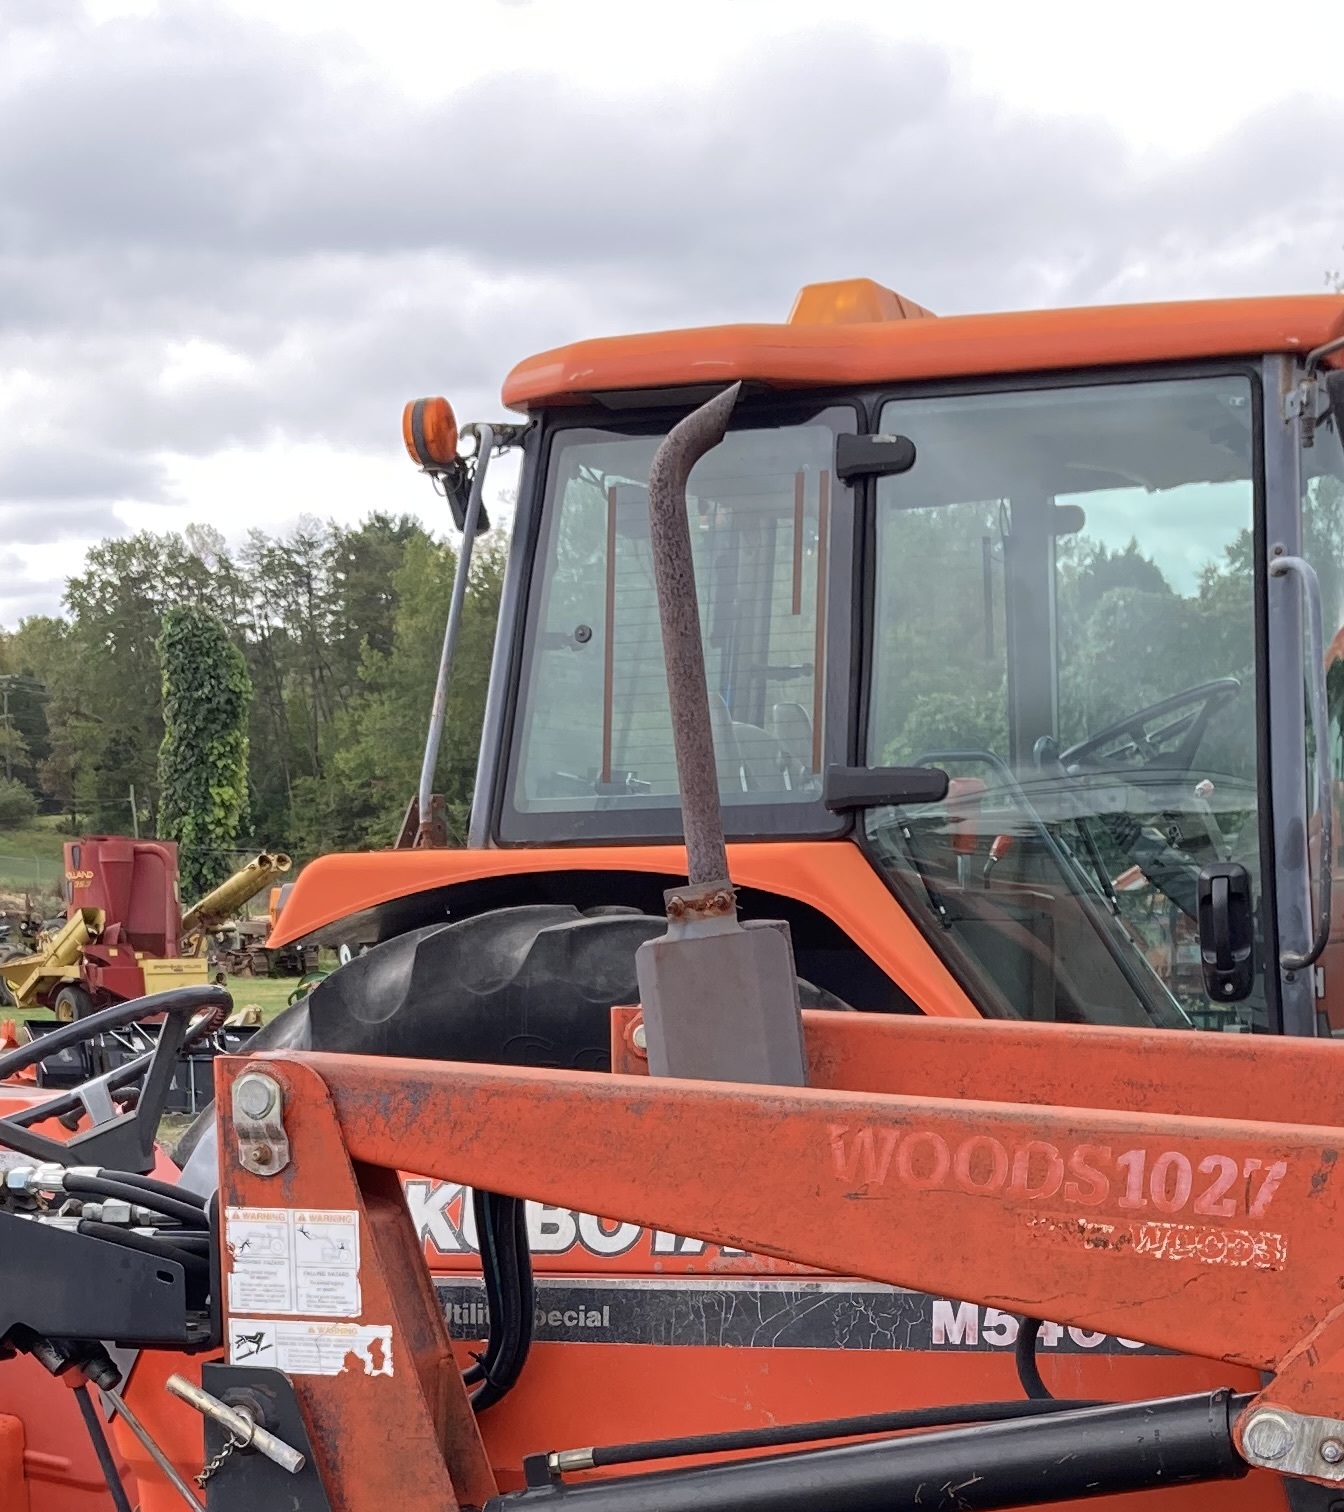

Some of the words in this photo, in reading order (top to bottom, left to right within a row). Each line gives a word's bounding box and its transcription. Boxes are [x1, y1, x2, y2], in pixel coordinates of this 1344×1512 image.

[242, 1212, 286, 1222] WARNING
[308, 1214, 353, 1224] WARNING
[535, 1304, 610, 1330] pecial
[317, 1325, 358, 1336] WARNING
